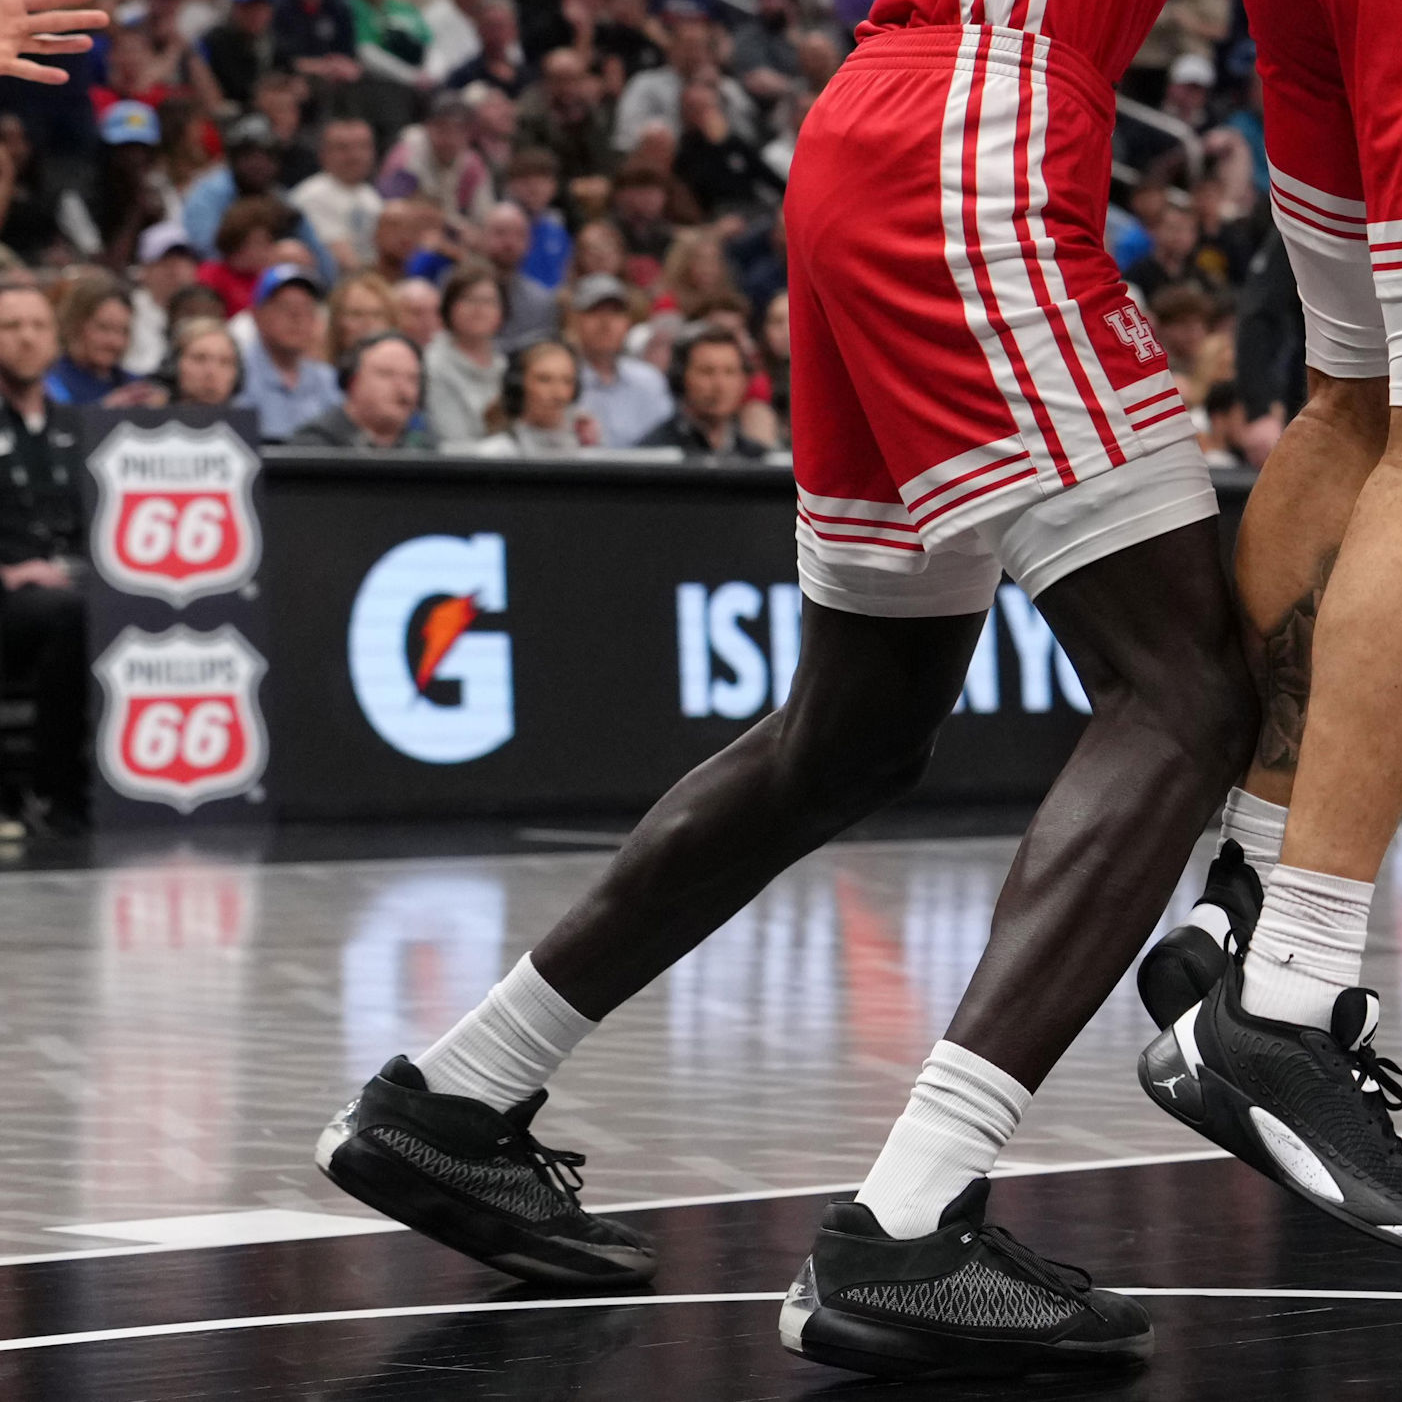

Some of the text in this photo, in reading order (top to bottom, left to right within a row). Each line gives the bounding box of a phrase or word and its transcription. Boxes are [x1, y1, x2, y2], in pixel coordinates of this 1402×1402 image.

[120, 451, 232, 482] PHILLIPS
[125, 497, 227, 565] 66
[125, 657, 238, 687] PHILLIPS
[348, 532, 515, 764] G
[132, 699, 234, 768] 66
